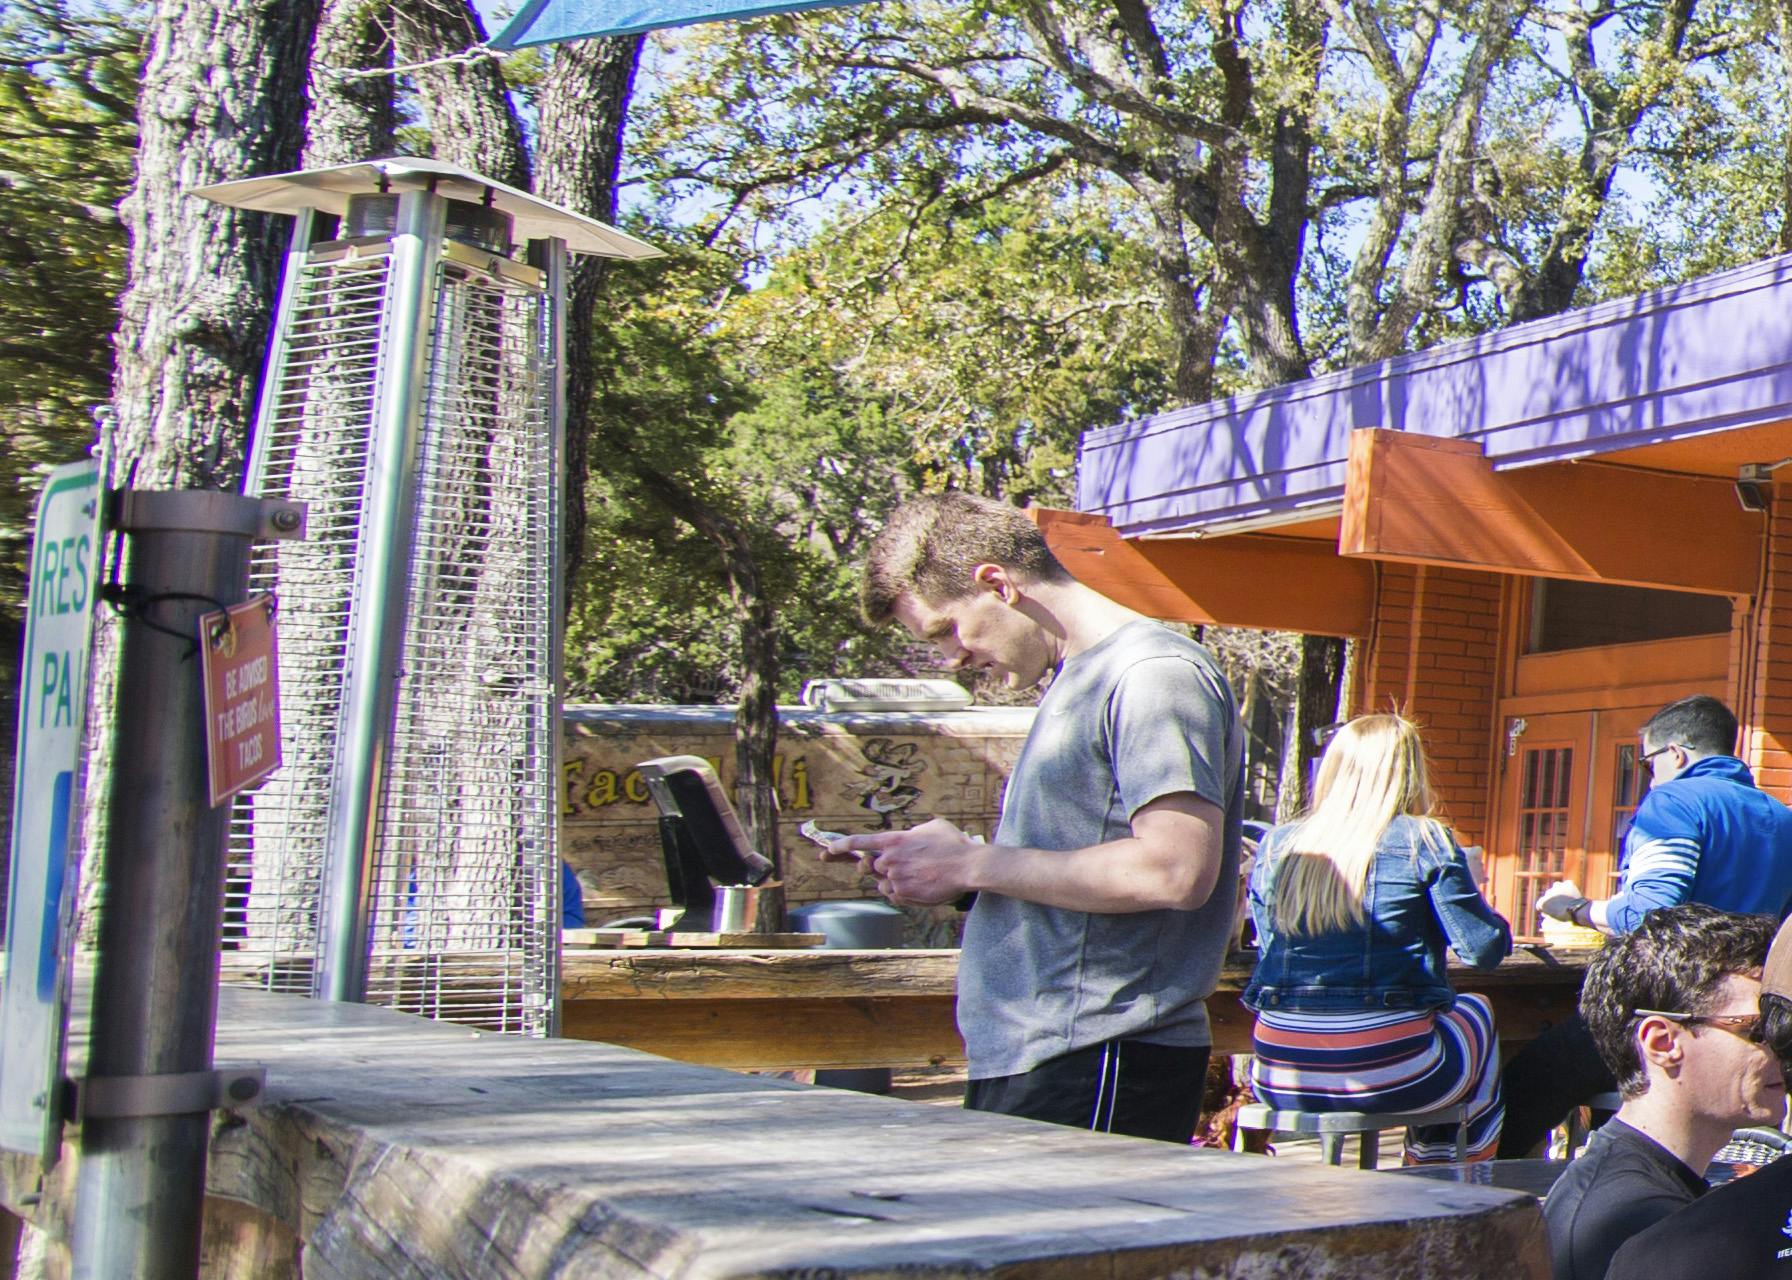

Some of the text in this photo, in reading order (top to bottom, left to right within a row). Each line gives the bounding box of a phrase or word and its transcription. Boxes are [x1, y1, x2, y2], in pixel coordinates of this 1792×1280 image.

[38, 649, 83, 729] PA
[217, 708, 235, 742] THE
[235, 696, 258, 734] BIRDS
[238, 732, 263, 770] TACOS
